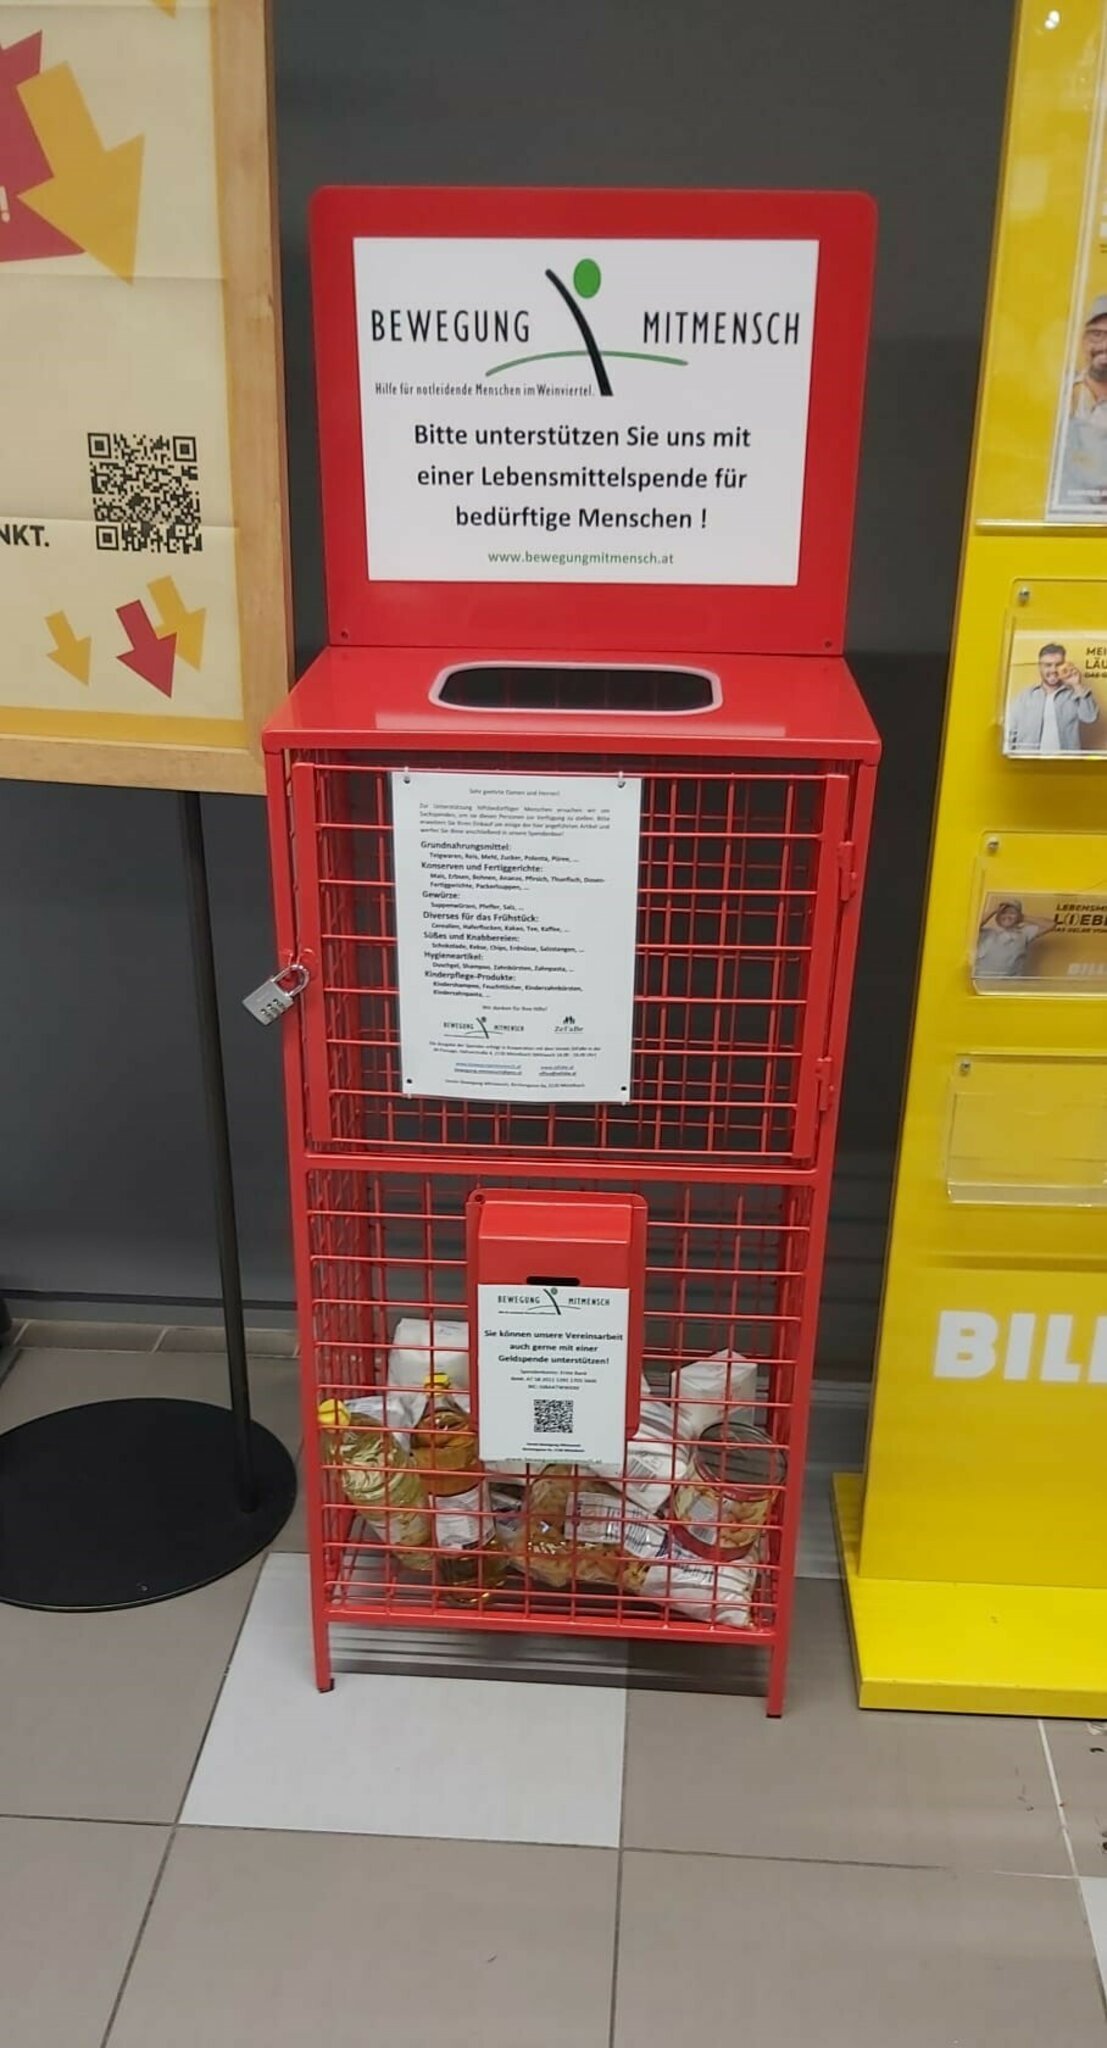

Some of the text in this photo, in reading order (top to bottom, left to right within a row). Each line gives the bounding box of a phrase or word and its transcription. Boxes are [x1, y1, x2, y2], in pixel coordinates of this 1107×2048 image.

[371, 310, 800, 345] BEWEGUNG MITMENSCH
[375, 382, 595, 397] Hilfe für notleidende Menschen im Weinviertel.
[414, 425, 751, 447] Bitte unterstützen Sie uns mit
[417, 466, 747, 492] einer Lebensmittelspende für
[456, 506, 707, 531] bedürftige Menschen !
[488, 551, 674, 566] www.bewegungmitmensch.at
[420, 840, 511, 851] Grundnahrungsmittel:
[421, 861, 542, 874] Konserven und Fertiggerichte:
[422, 890, 459, 899] Gewürze:
[422, 910, 538, 922] Diverses für das Frühstück:
[423, 931, 519, 942] Süßes und Knabbereien:
[424, 951, 483, 961] Hygieneartikel:
[424, 970, 515, 982] Kinderpflege-Produkte:
[499, 1329, 531, 1337] können
[565, 1331, 622, 1340] Vereinsarbeit
[532, 1344, 556, 1352] gerne
[575, 1344, 598, 1352] einer
[498, 1354, 609, 1364] Geldspende unterstützen!
